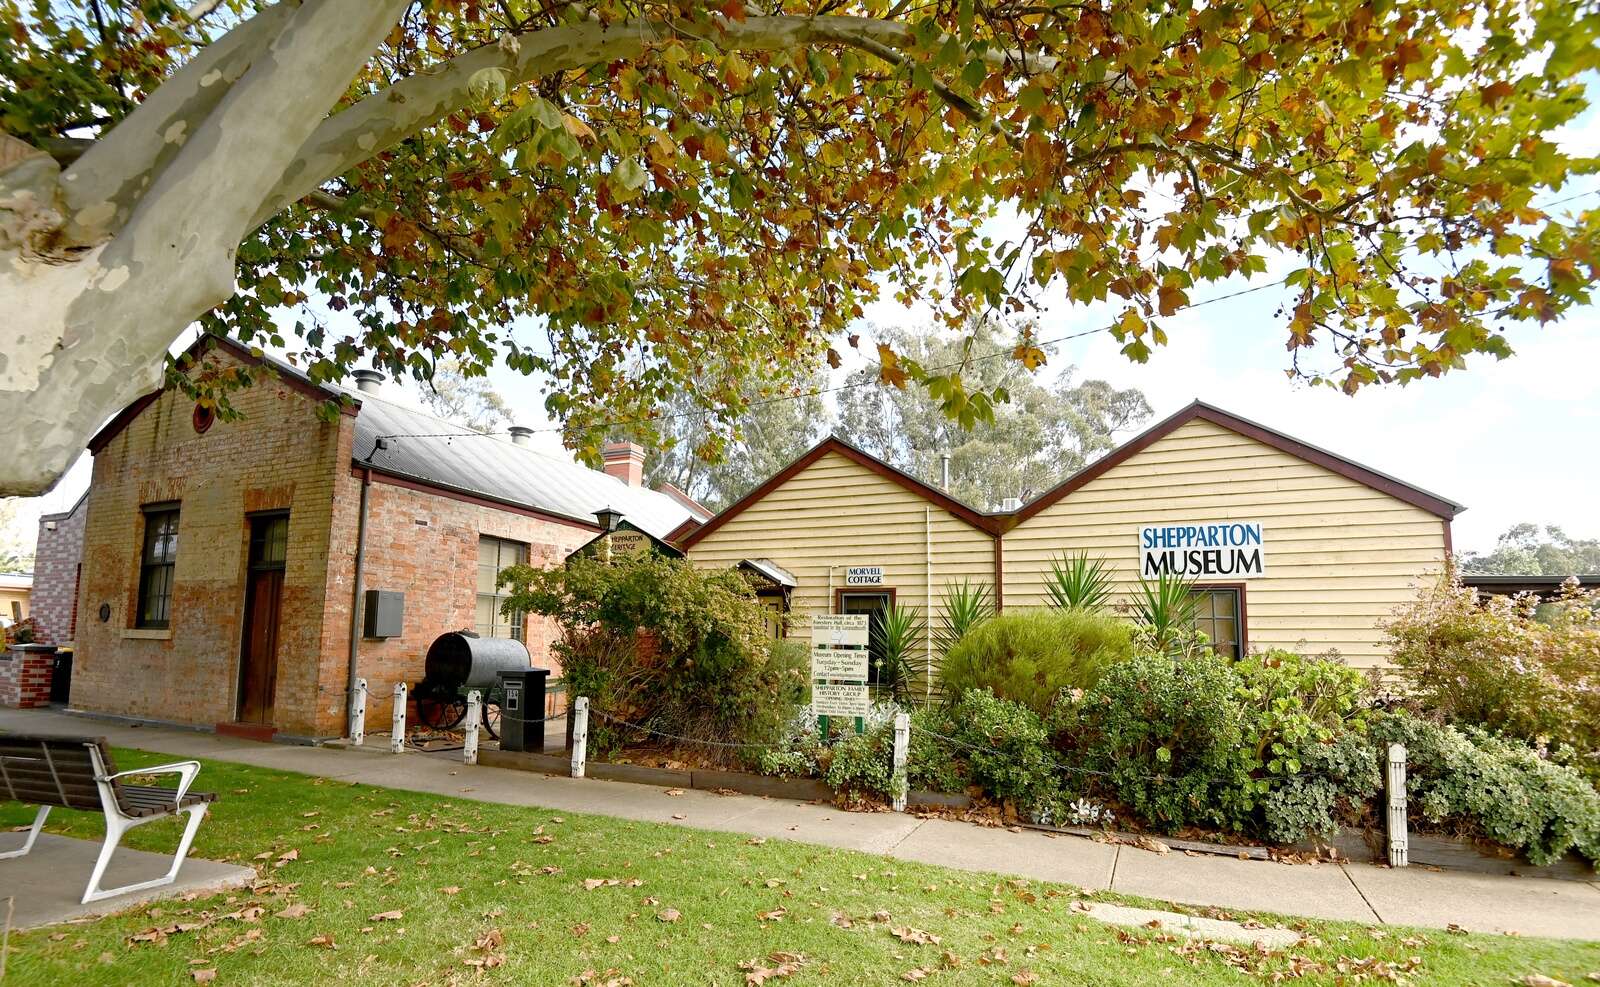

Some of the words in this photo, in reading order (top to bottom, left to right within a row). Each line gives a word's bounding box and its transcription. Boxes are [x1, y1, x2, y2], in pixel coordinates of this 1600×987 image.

[611, 535, 643, 543] HEPPARTON
[1143, 523, 1261, 549] SHEPPARTON
[1144, 549, 1262, 576] MUSEUM
